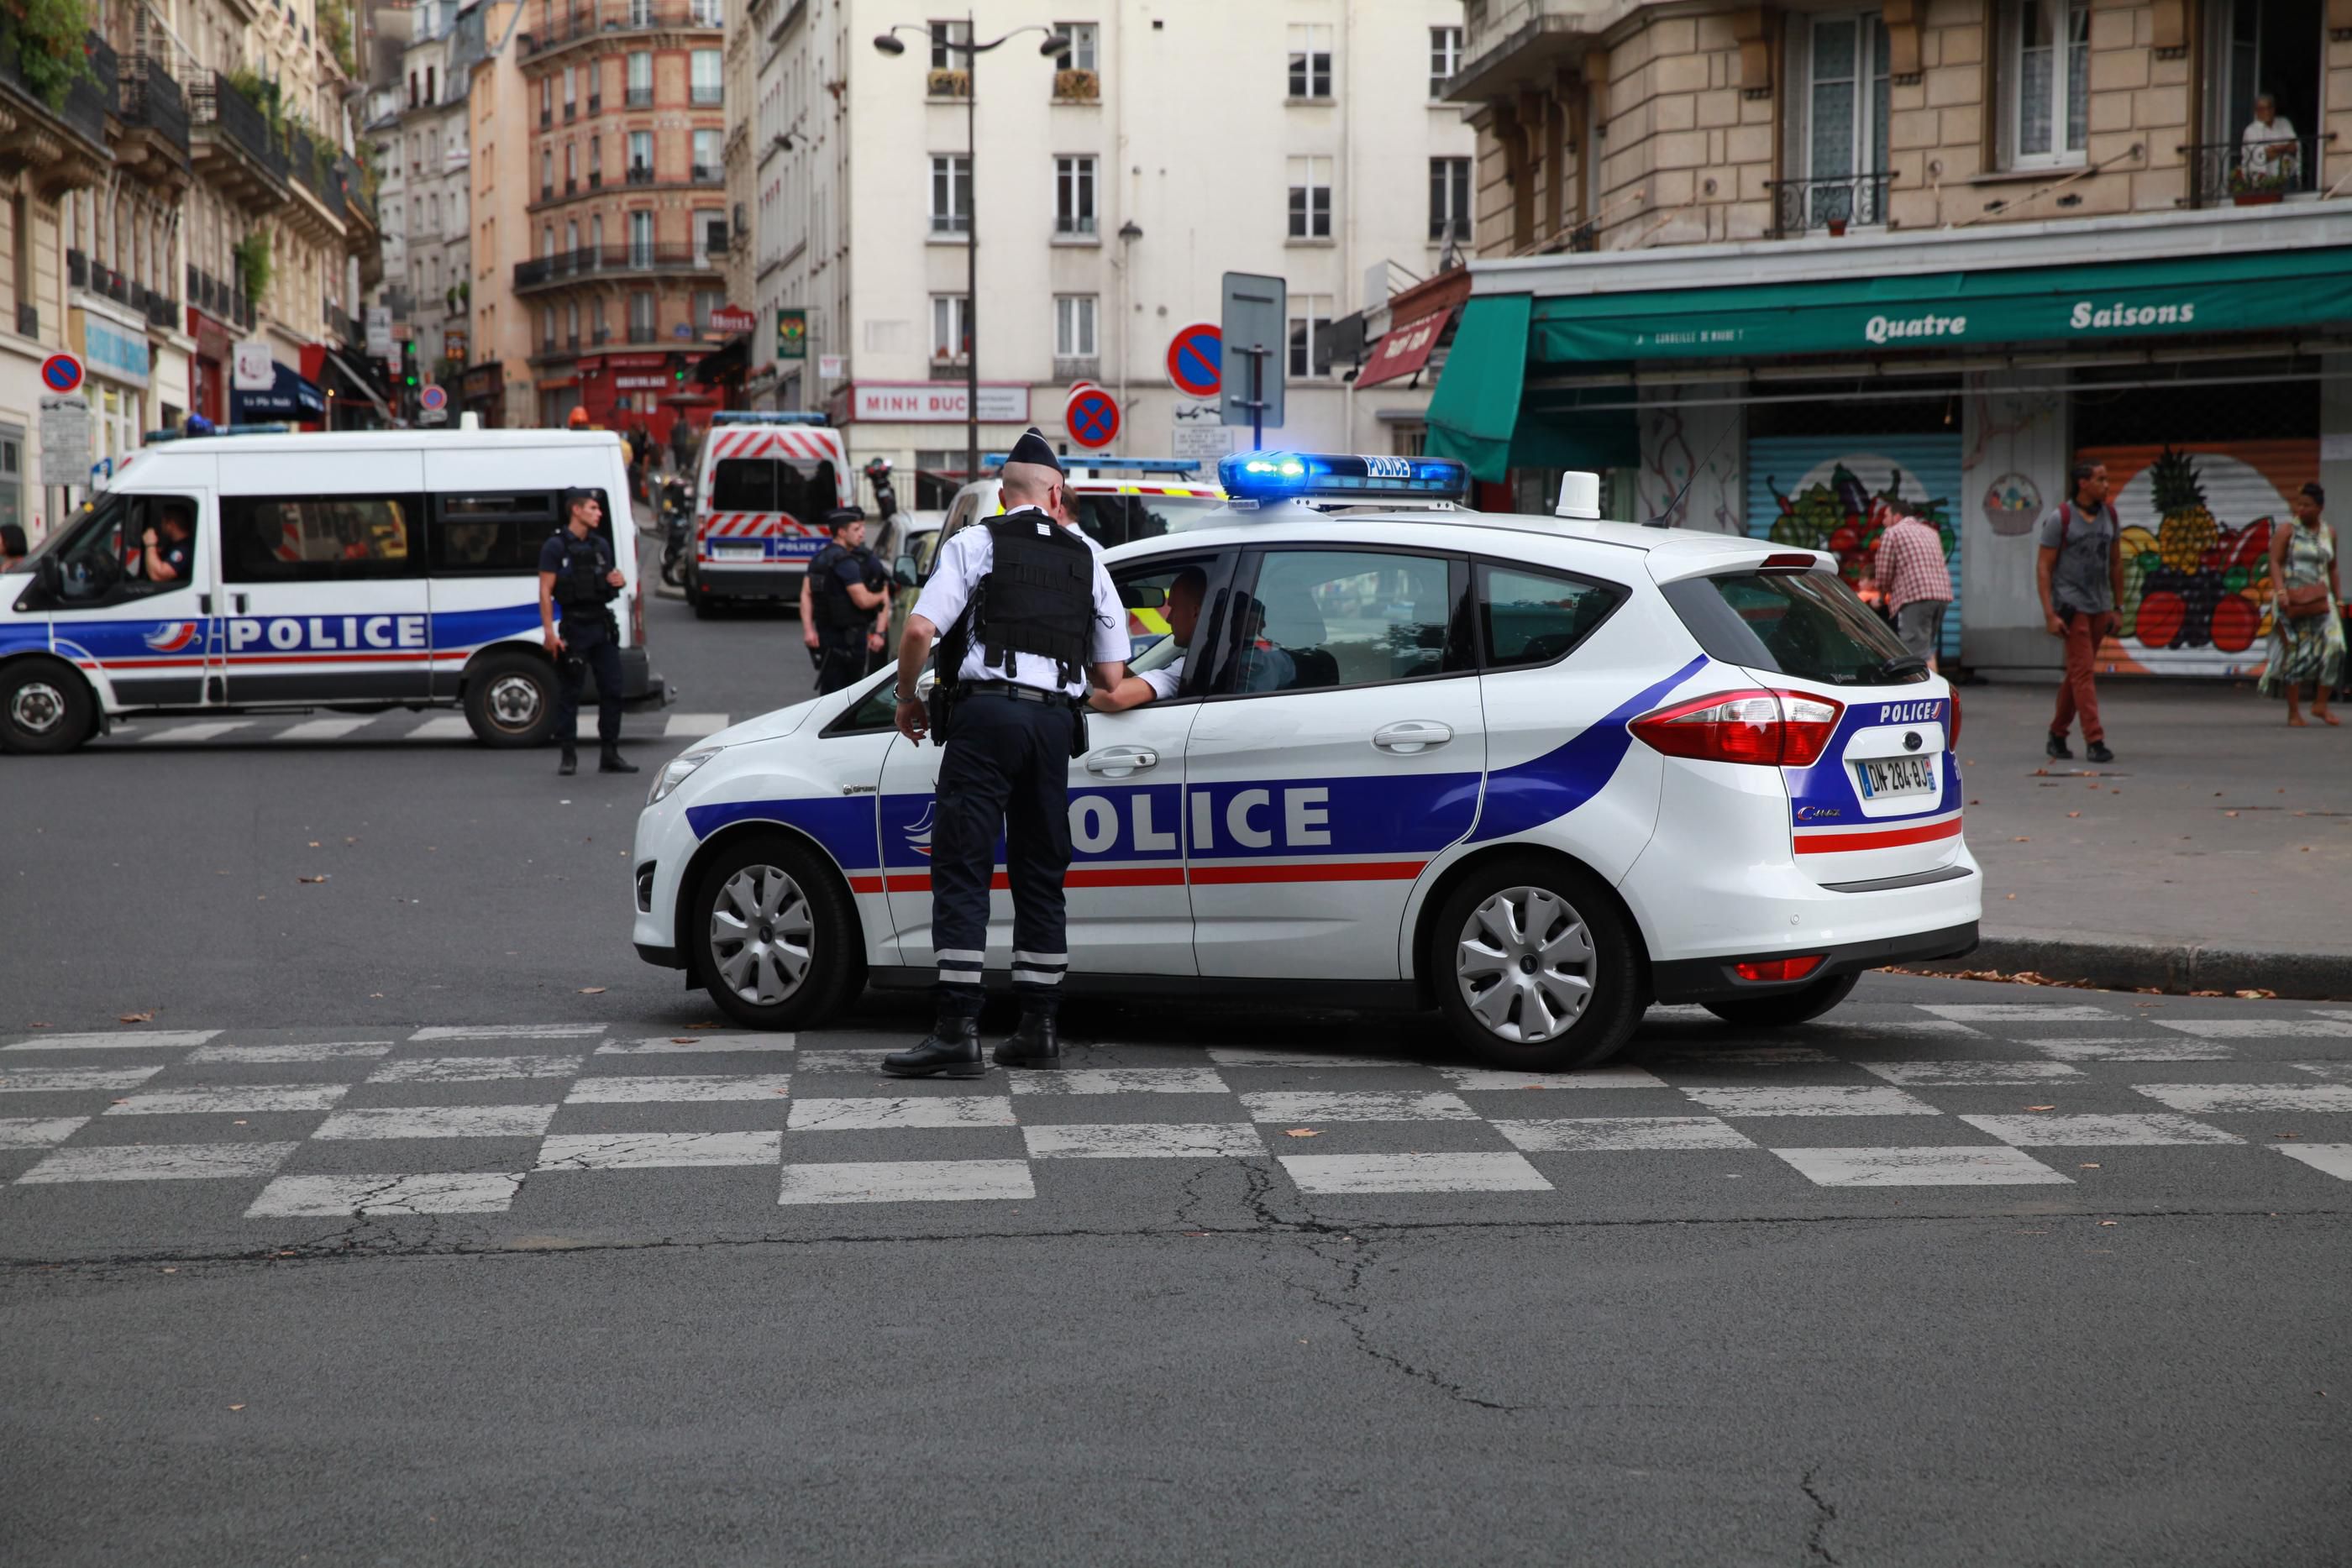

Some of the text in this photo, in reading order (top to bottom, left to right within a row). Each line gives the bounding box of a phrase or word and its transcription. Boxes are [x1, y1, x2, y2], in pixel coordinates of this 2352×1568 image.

[1866, 302, 2195, 343] Quatre Saisons
[866, 396, 918, 411] MINH
[1362, 456, 1409, 477] POLICE
[228, 616, 426, 650] POLICE
[1880, 702, 1931, 723] POLICE
[1068, 787, 1331, 853] OLICE
